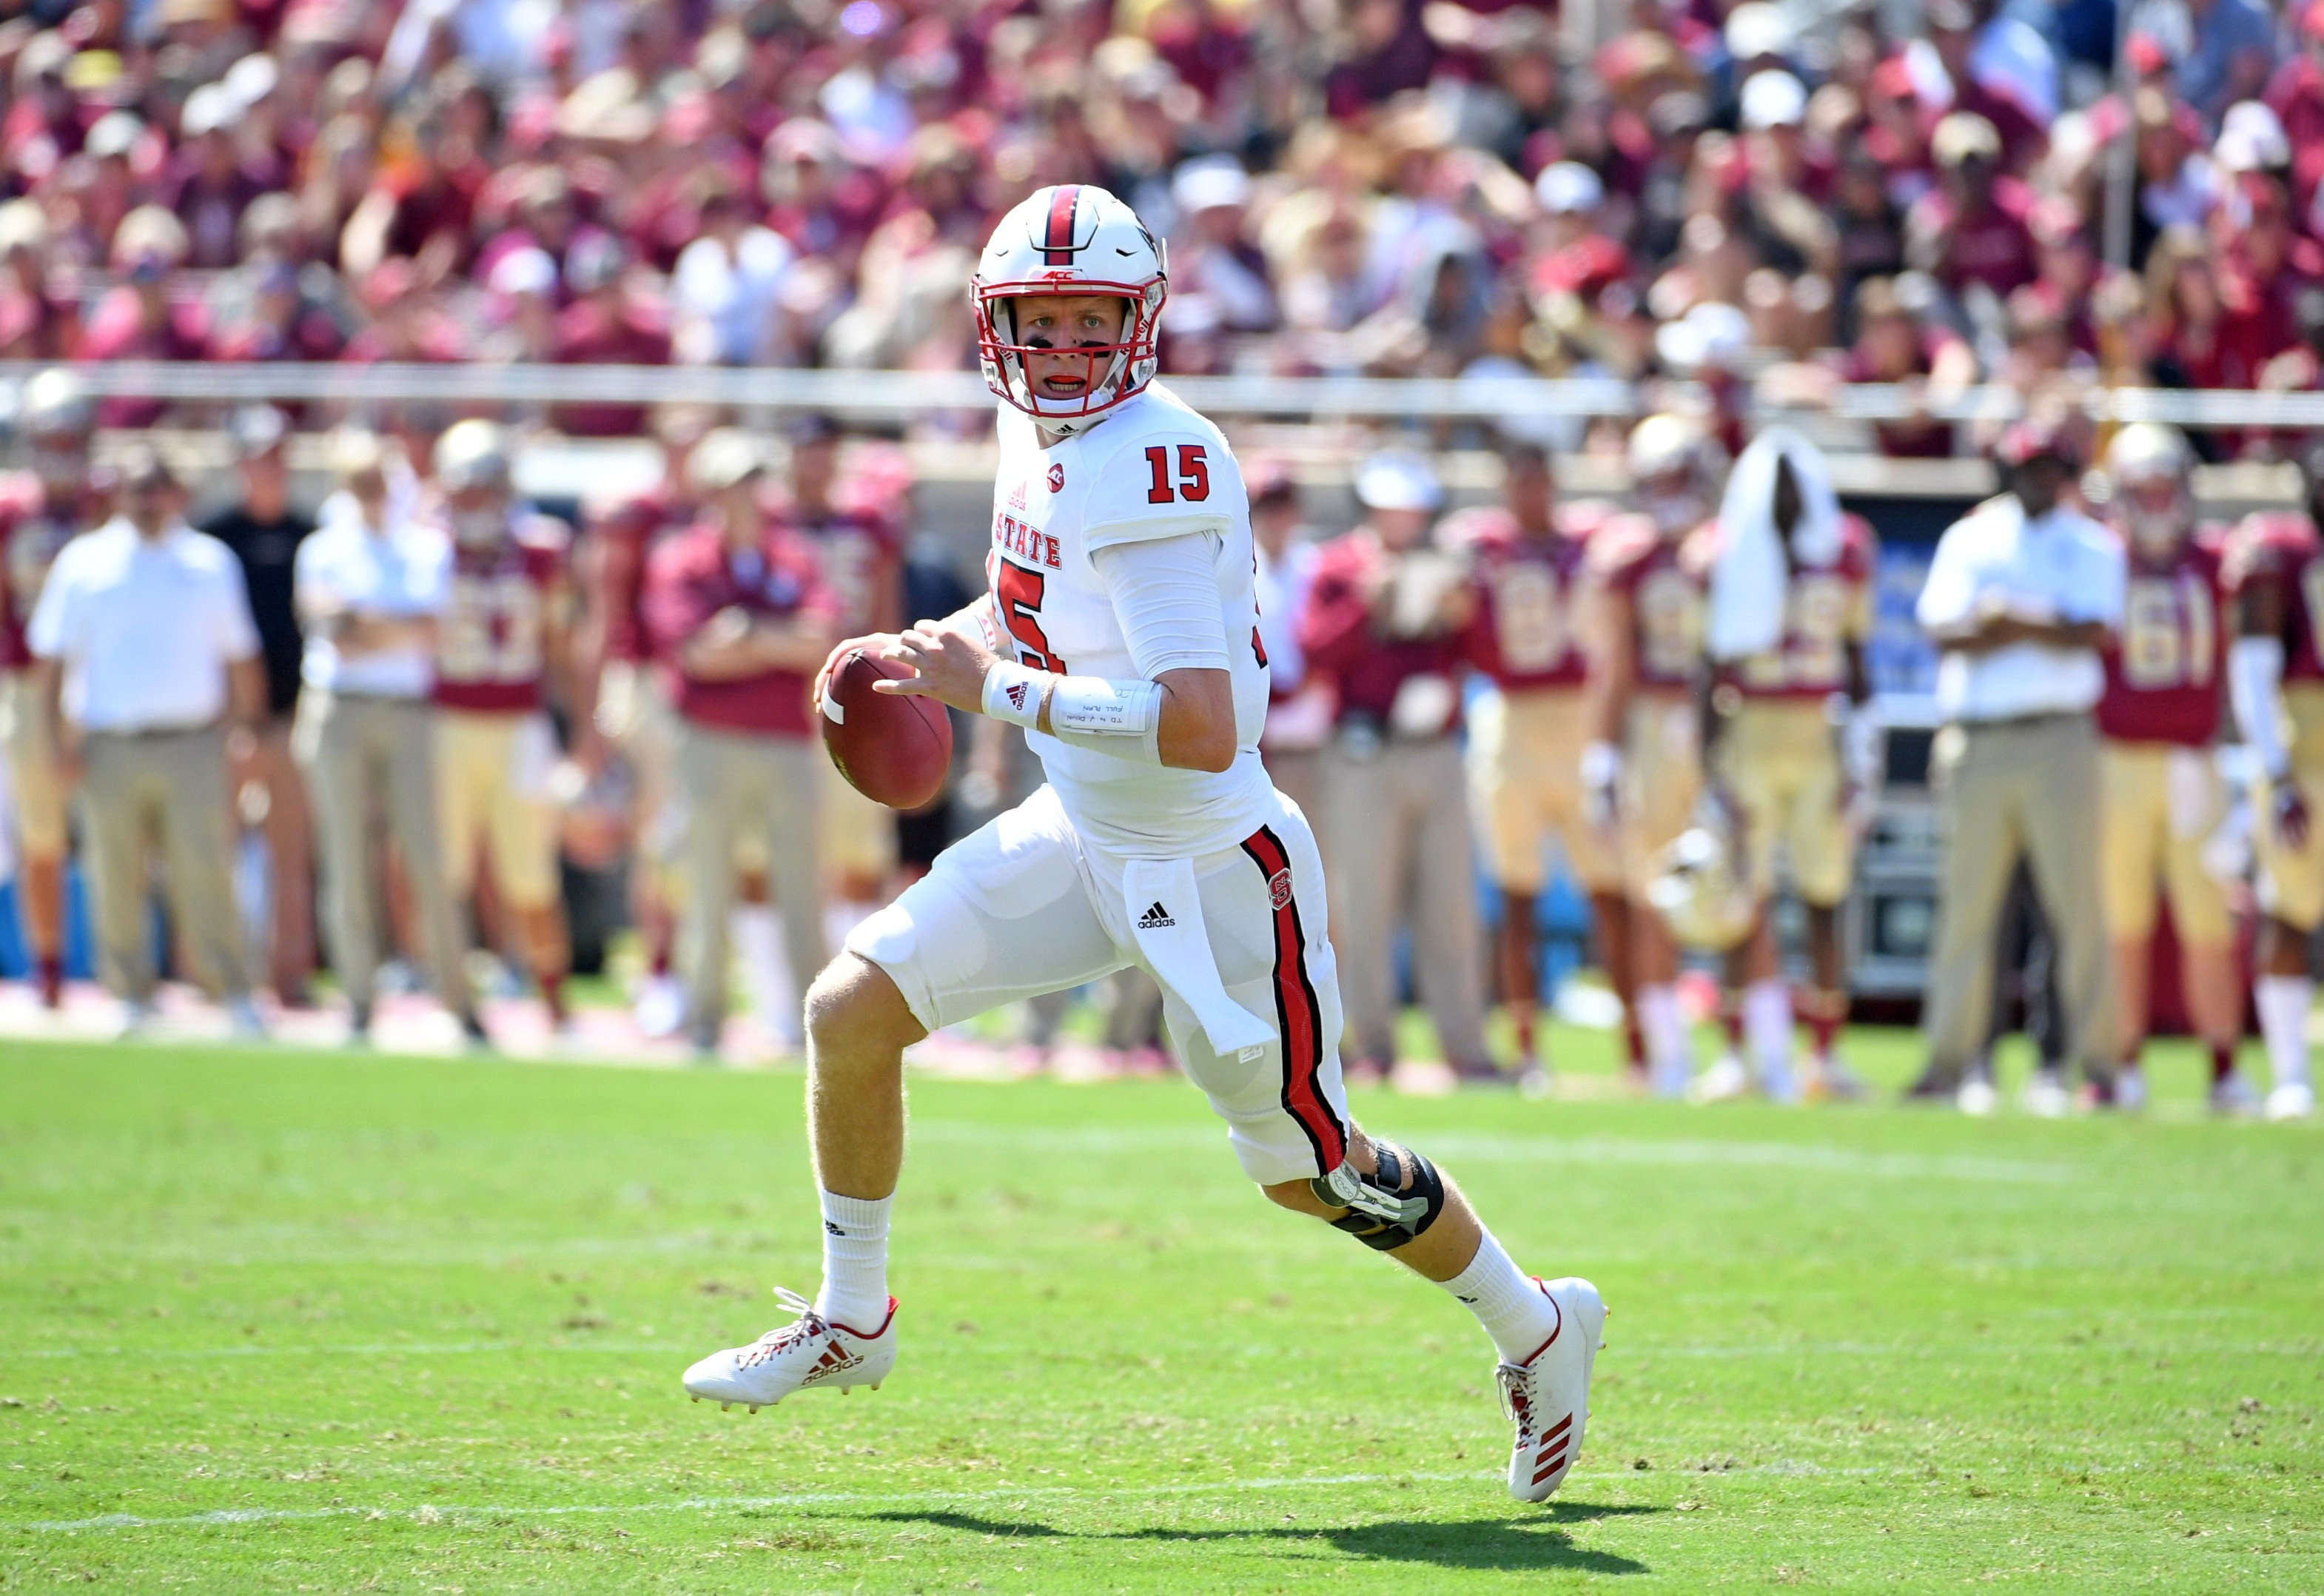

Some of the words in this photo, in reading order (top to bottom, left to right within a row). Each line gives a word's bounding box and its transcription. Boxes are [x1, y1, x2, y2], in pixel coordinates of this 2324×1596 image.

[1145, 444, 1210, 505] 15
[995, 512, 1062, 570] STATE
[1015, 681, 1029, 711] adidas
[1138, 916, 1176, 929] adidas
[801, 1355, 865, 1386] adidas
